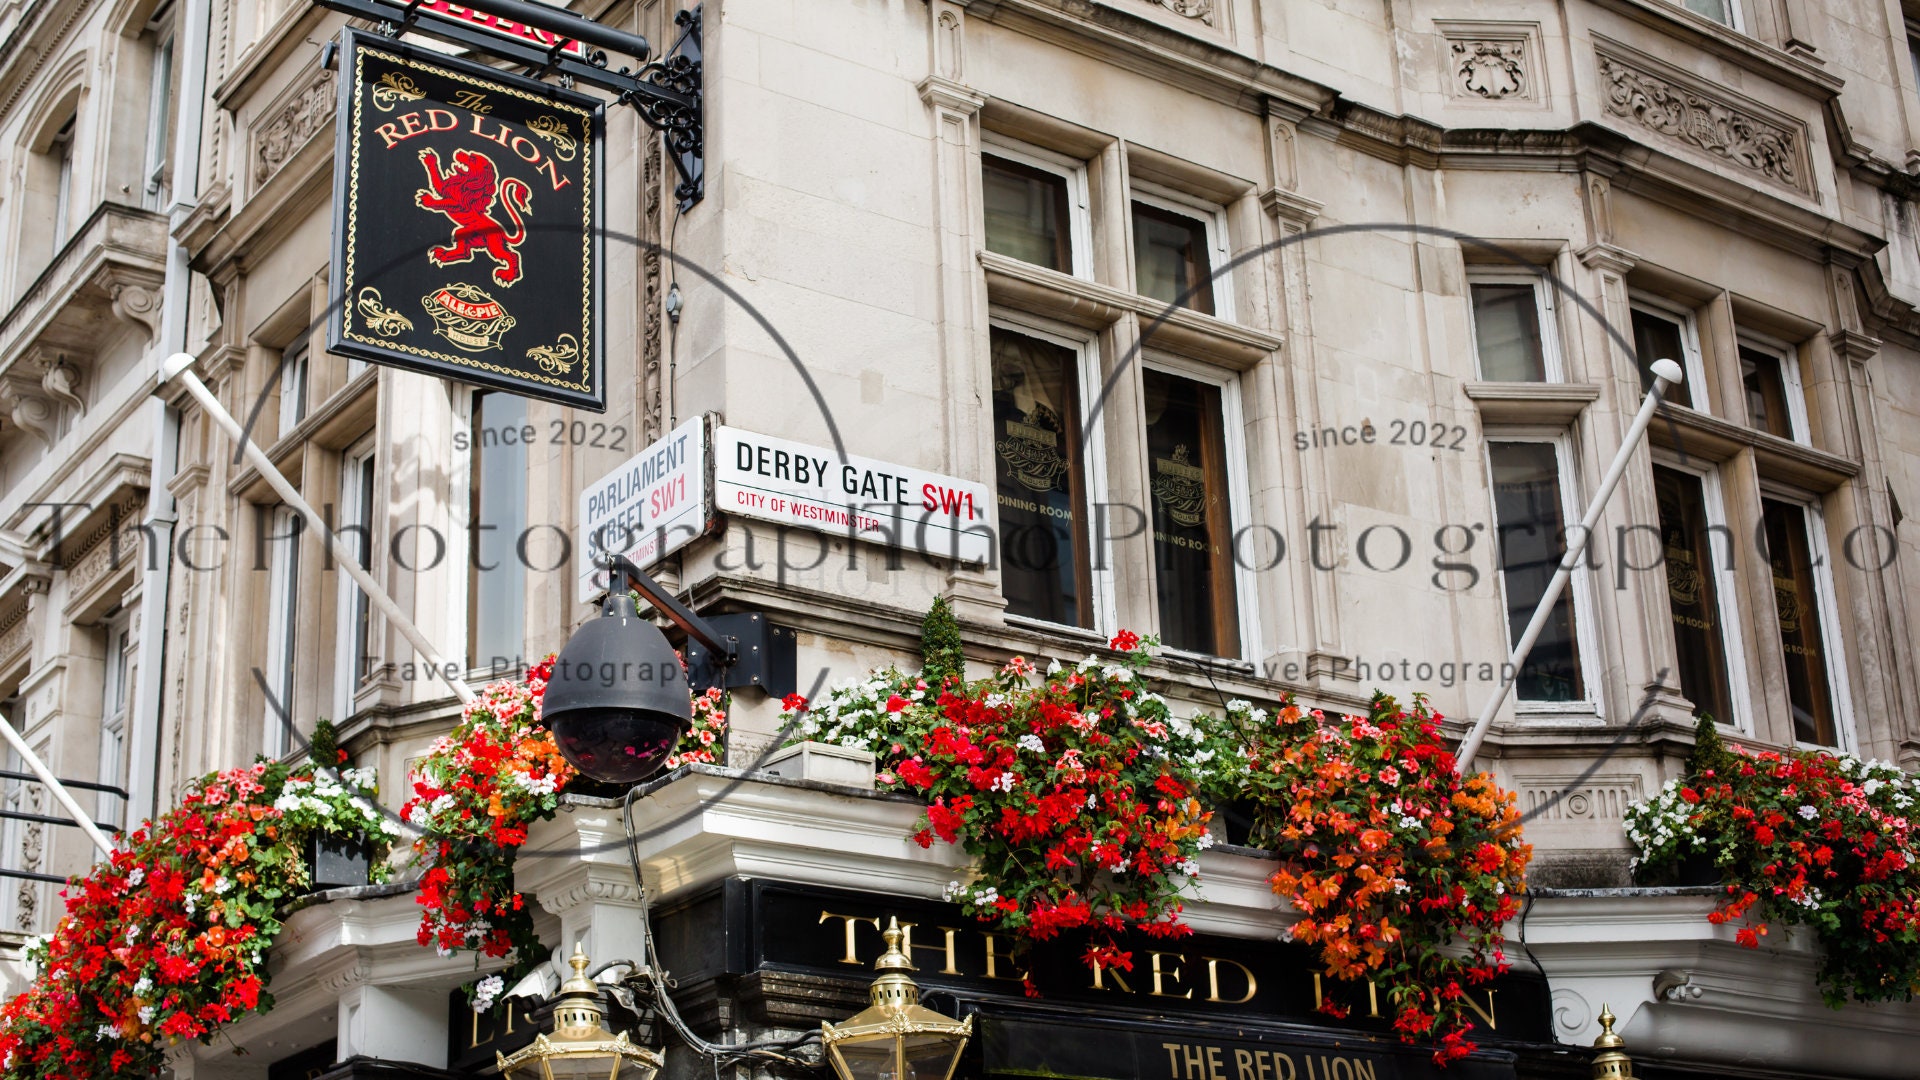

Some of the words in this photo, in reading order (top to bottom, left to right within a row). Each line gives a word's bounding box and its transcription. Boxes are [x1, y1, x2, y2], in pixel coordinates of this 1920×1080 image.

[446, 89, 493, 115] The
[374, 109, 459, 150] RED
[470, 113, 572, 191] LION
[453, 332, 485, 346] HOUSE
[588, 434, 688, 525] PARLIAMENT
[736, 440, 829, 487] DERBY
[841, 465, 909, 506] GATE
[921, 482, 974, 521] SW1
[997, 494, 1037, 512] DINING
[1039, 504, 1073, 520] ROOM
[588, 498, 645, 560] STREET
[651, 473, 686, 519] SW1
[737, 490, 766, 509] CITY
[771, 497, 787, 512] OF
[790, 501, 880, 533] WESTMINSTER
[819, 910, 1029, 982] THE
[1163, 1043, 1227, 1080] THE
[1234, 1049, 1296, 1080] RED
